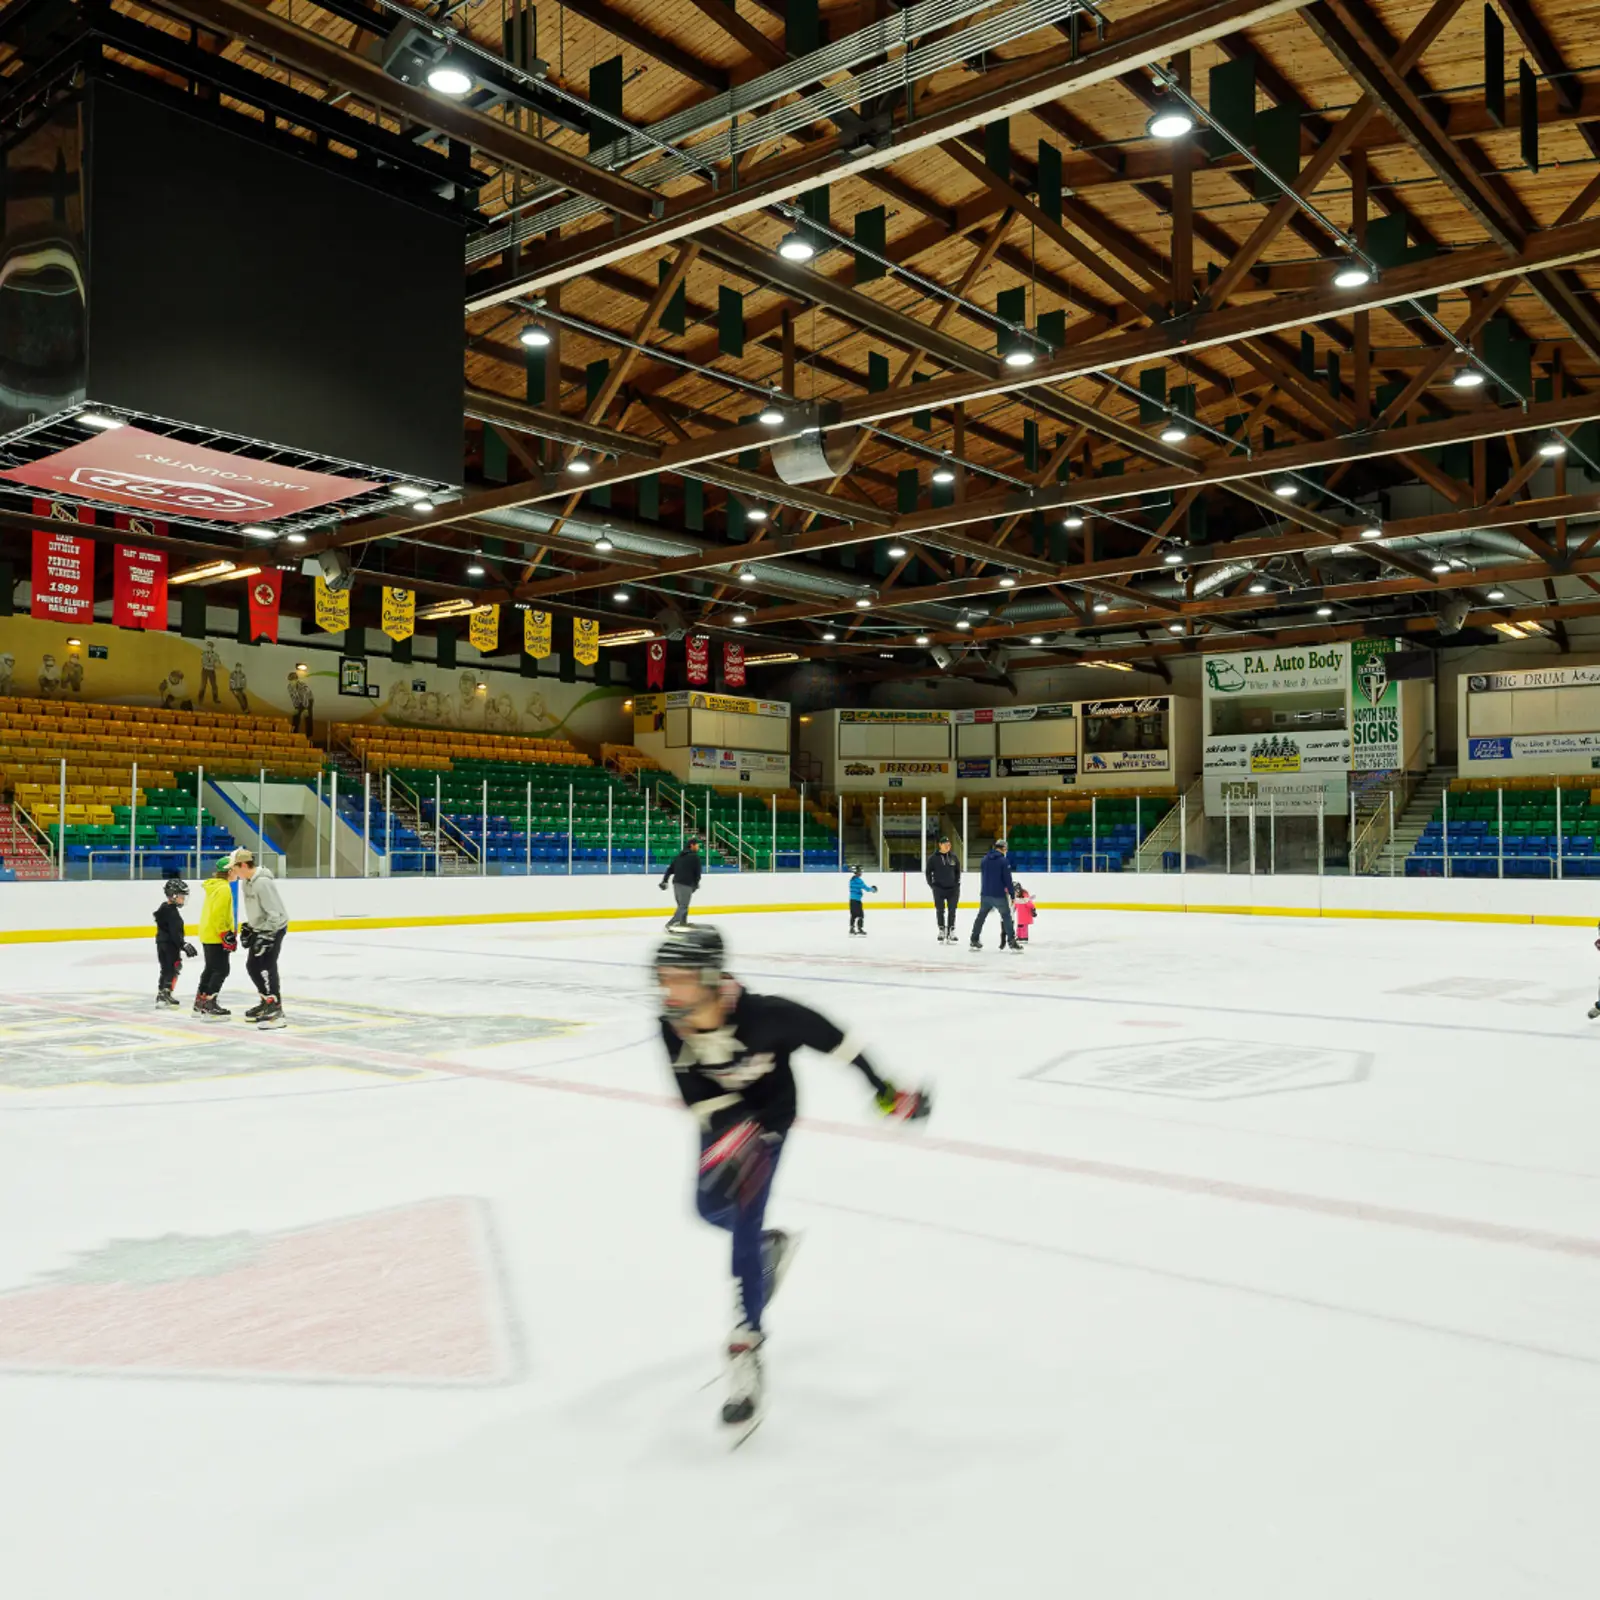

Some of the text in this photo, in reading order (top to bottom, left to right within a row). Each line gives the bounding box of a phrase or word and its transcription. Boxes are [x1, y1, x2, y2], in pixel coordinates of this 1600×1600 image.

[134, 453, 310, 492] LAKE COUNTRY
[49, 582, 79, 594] 1999
[64, 598, 90, 608] ALBERT
[1244, 650, 1343, 674] P.A. Auto Body
[1495, 675, 1516, 688] BIG
[1524, 672, 1565, 685] DRUM
[1088, 702, 1133, 715] Canadian
[1134, 698, 1160, 713] Club
[856, 711, 946, 720] CAMPBELL
[1353, 706, 1397, 722] NORTH STAR
[1353, 721, 1399, 745] SIGNS
[1122, 752, 1156, 760] PURIFIED
[886, 763, 943, 773] BRODA
[1113, 759, 1166, 769] WATER STORE
